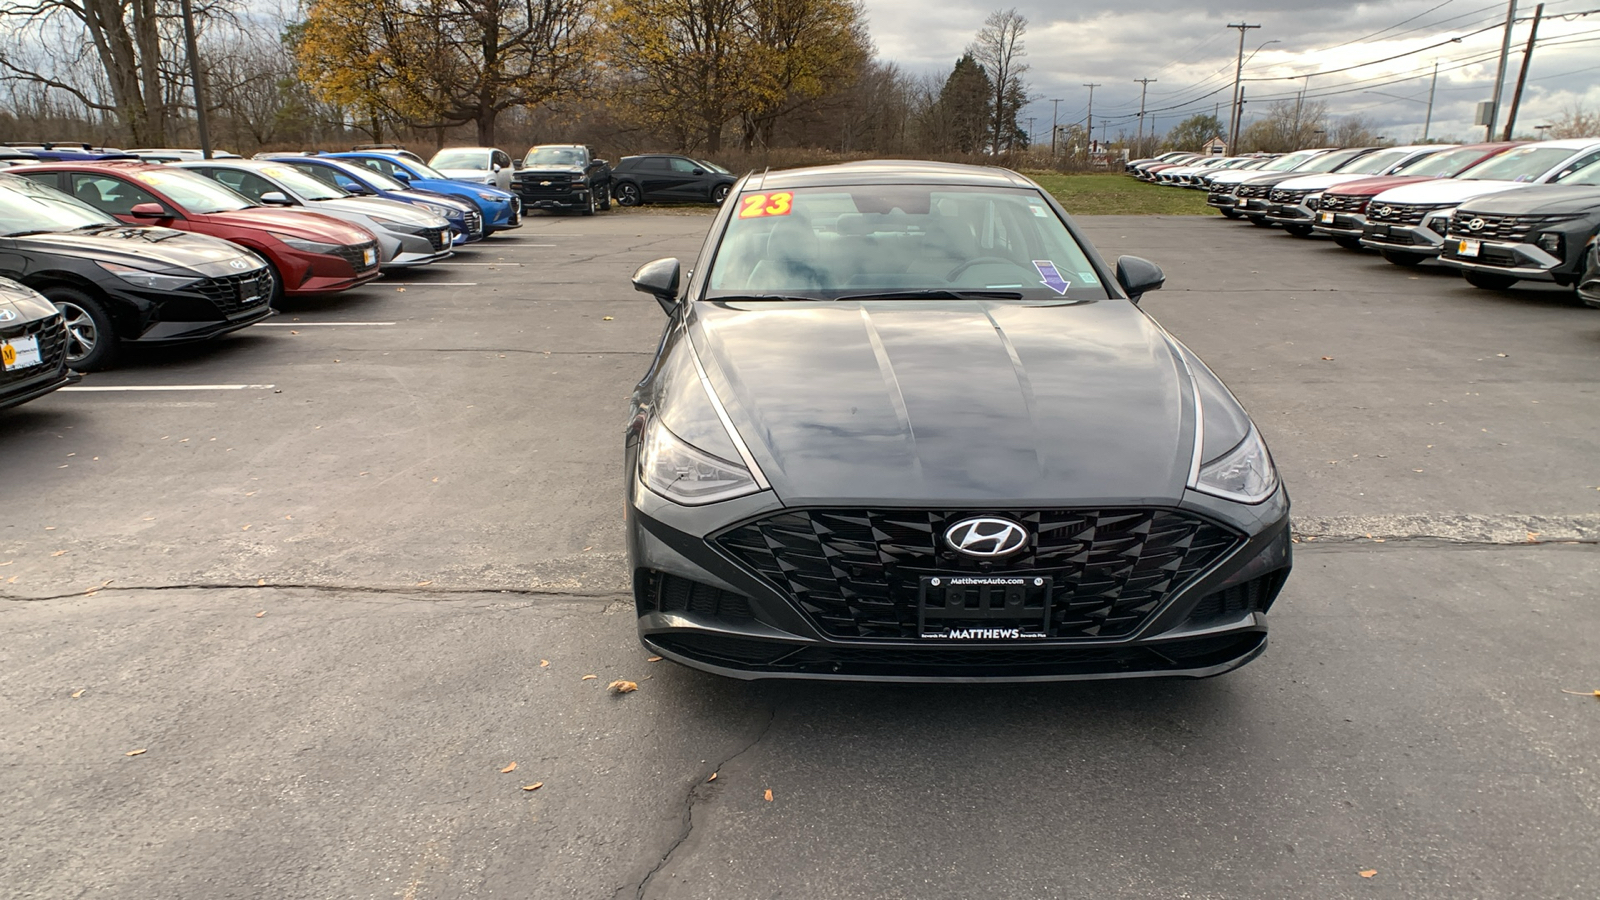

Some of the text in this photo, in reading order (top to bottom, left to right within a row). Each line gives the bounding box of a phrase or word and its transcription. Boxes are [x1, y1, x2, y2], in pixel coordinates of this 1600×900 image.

[740, 192, 792, 217] 23
[3, 348, 13, 361] M
[949, 629, 1019, 639] MATTHEWS
